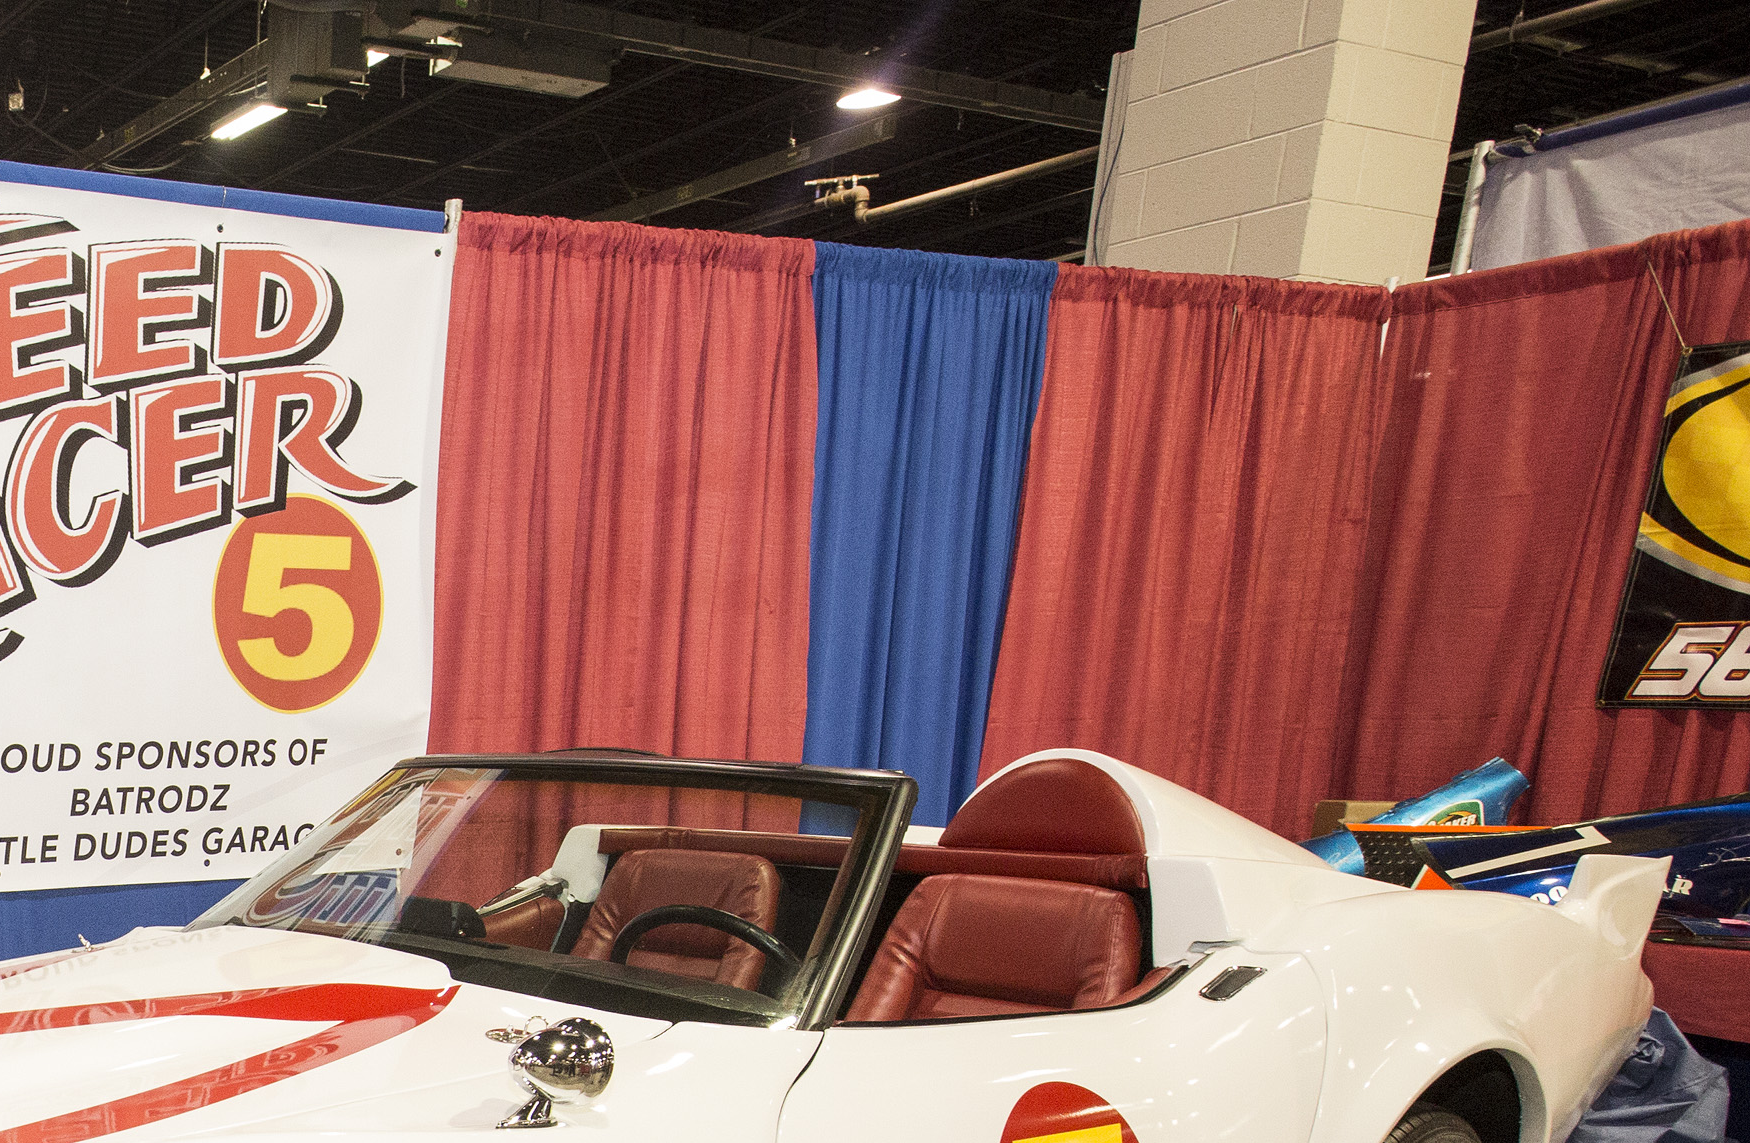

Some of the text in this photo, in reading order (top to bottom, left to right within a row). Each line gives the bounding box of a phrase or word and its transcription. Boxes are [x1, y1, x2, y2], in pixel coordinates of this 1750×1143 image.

[237, 532, 354, 681] 5
[94, 738, 277, 772] SPONSORS
[288, 738, 328, 767] OF
[69, 783, 231, 817] BATRODZ
[73, 828, 190, 862] DUDES
[201, 823, 315, 855] GARAG
